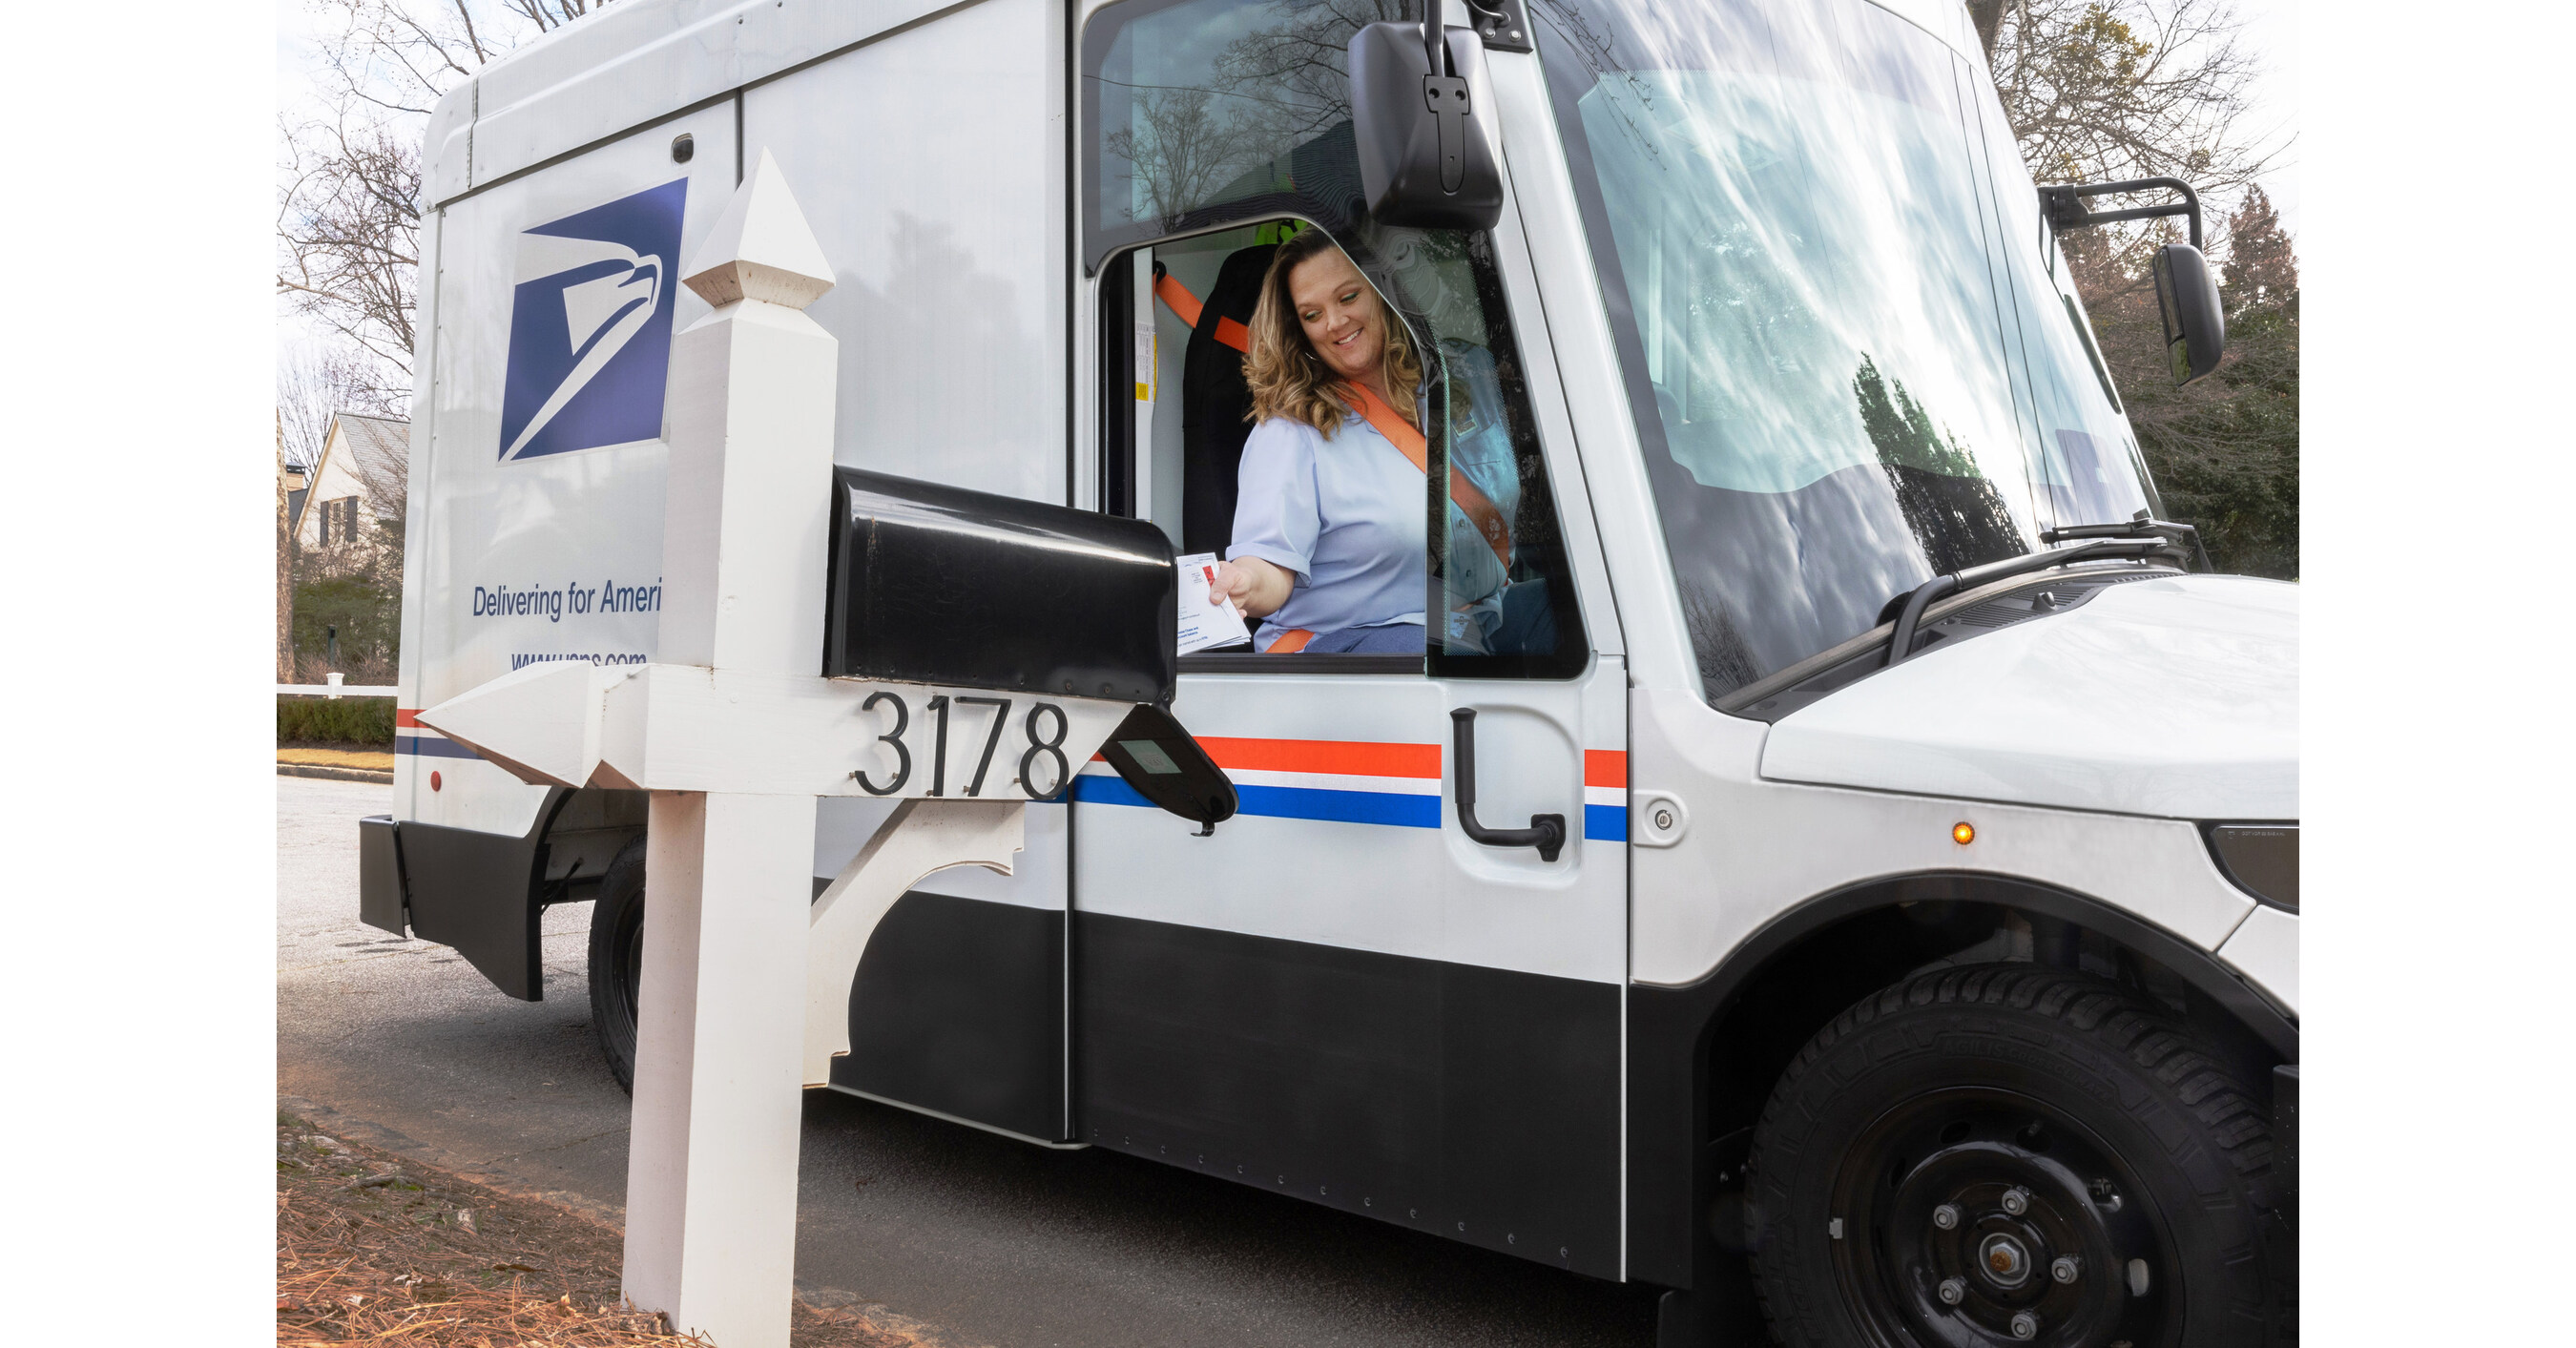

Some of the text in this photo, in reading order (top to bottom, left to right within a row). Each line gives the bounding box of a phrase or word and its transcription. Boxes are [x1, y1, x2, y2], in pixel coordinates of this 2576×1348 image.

[473, 584, 562, 623] Delivering
[568, 582, 596, 614] for
[855, 691, 1070, 799] 3178
[1943, 1039, 2005, 1058] AGILIS
